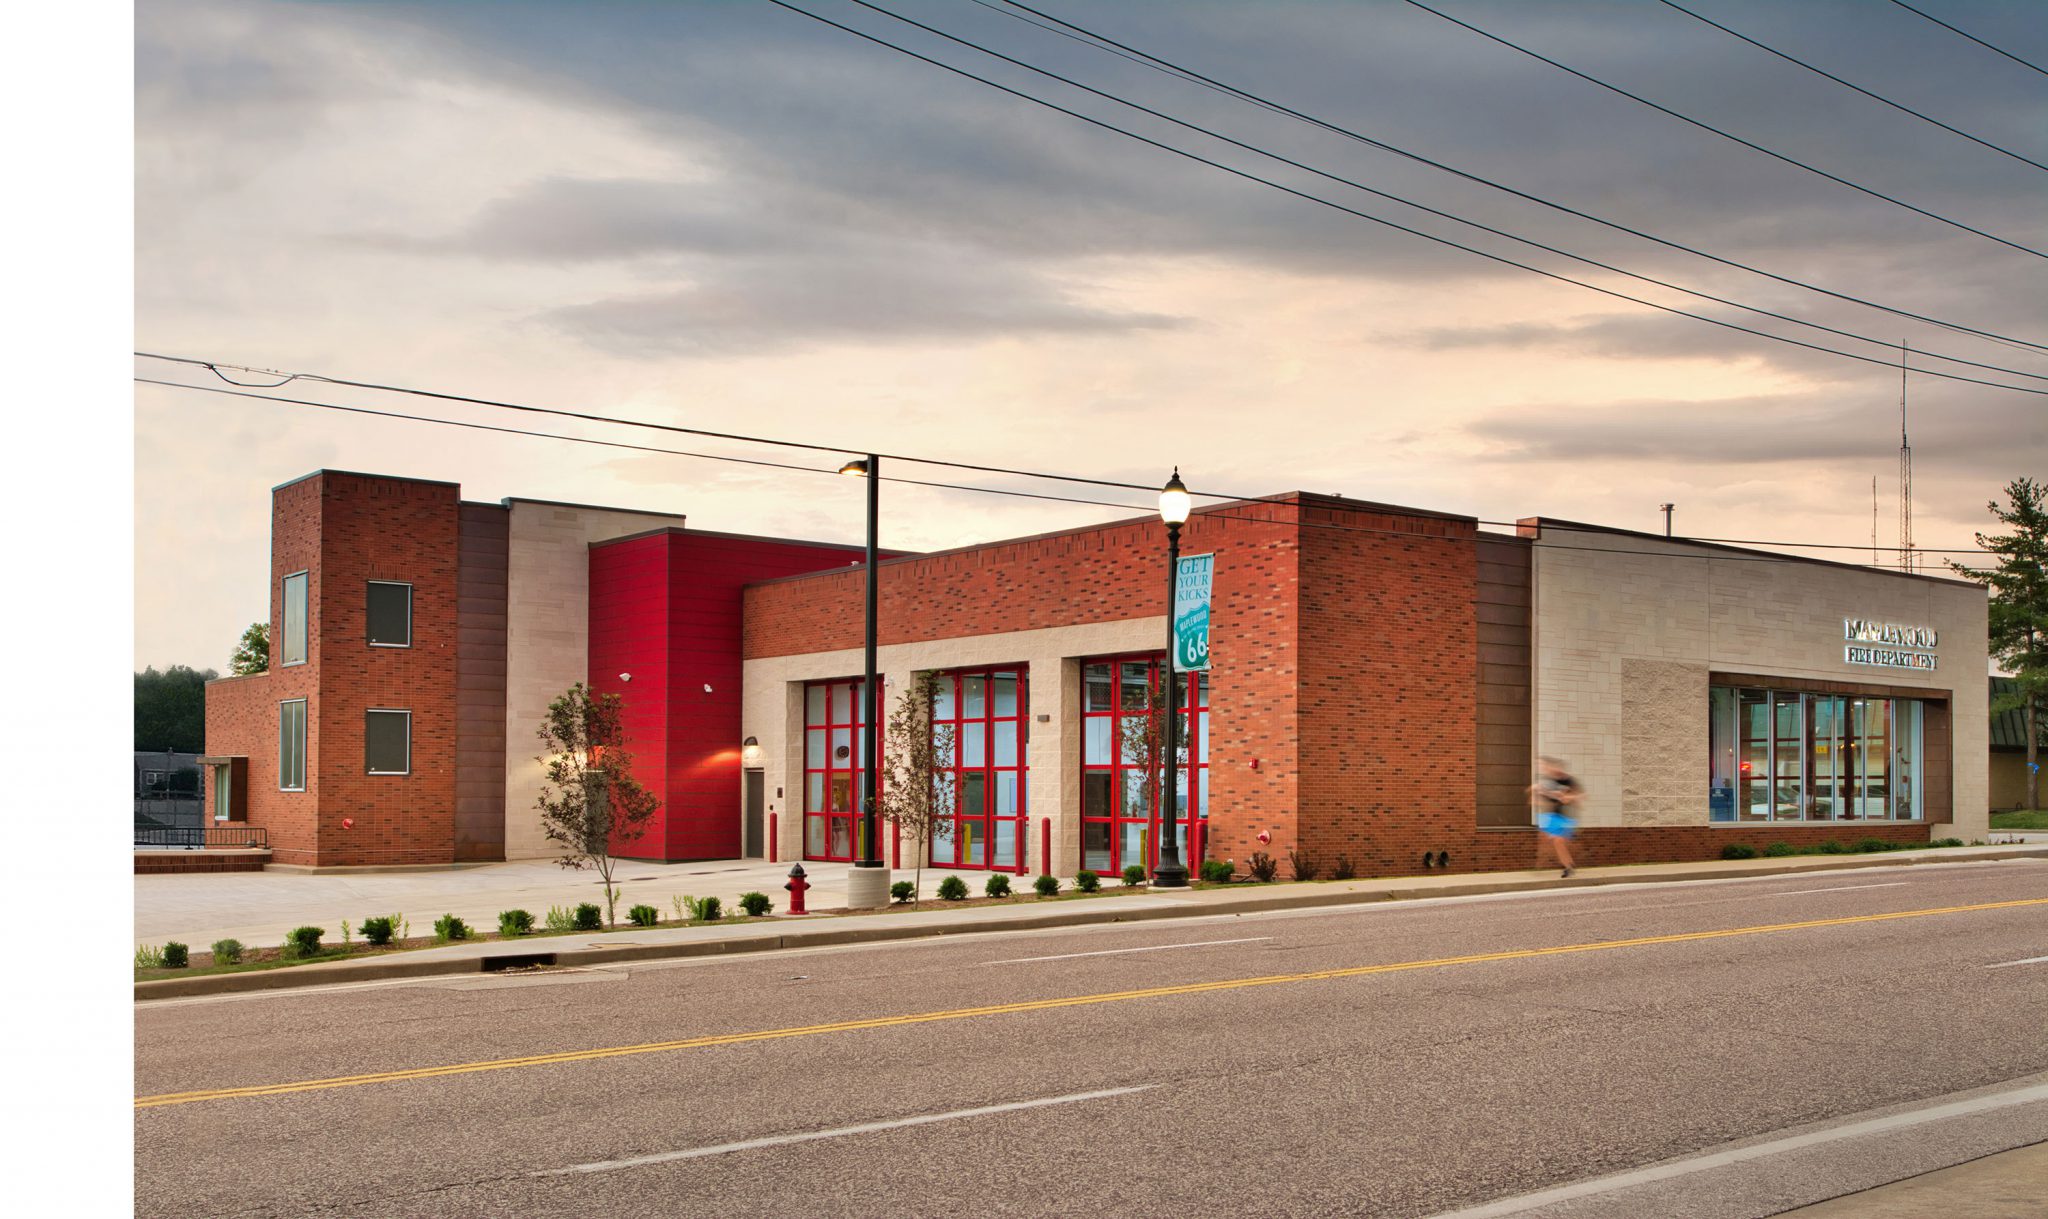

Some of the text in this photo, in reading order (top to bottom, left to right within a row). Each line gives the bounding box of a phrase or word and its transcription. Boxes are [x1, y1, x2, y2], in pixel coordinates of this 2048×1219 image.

[1180, 557, 1208, 575] GET
[1179, 575, 1208, 588] YOUR
[1178, 588, 1208, 601] KICKS
[1844, 619, 1938, 648] MAPLEWOOD
[1187, 632, 1207, 663] 66
[1846, 647, 1938, 670] FIRE DEPARTMENT
